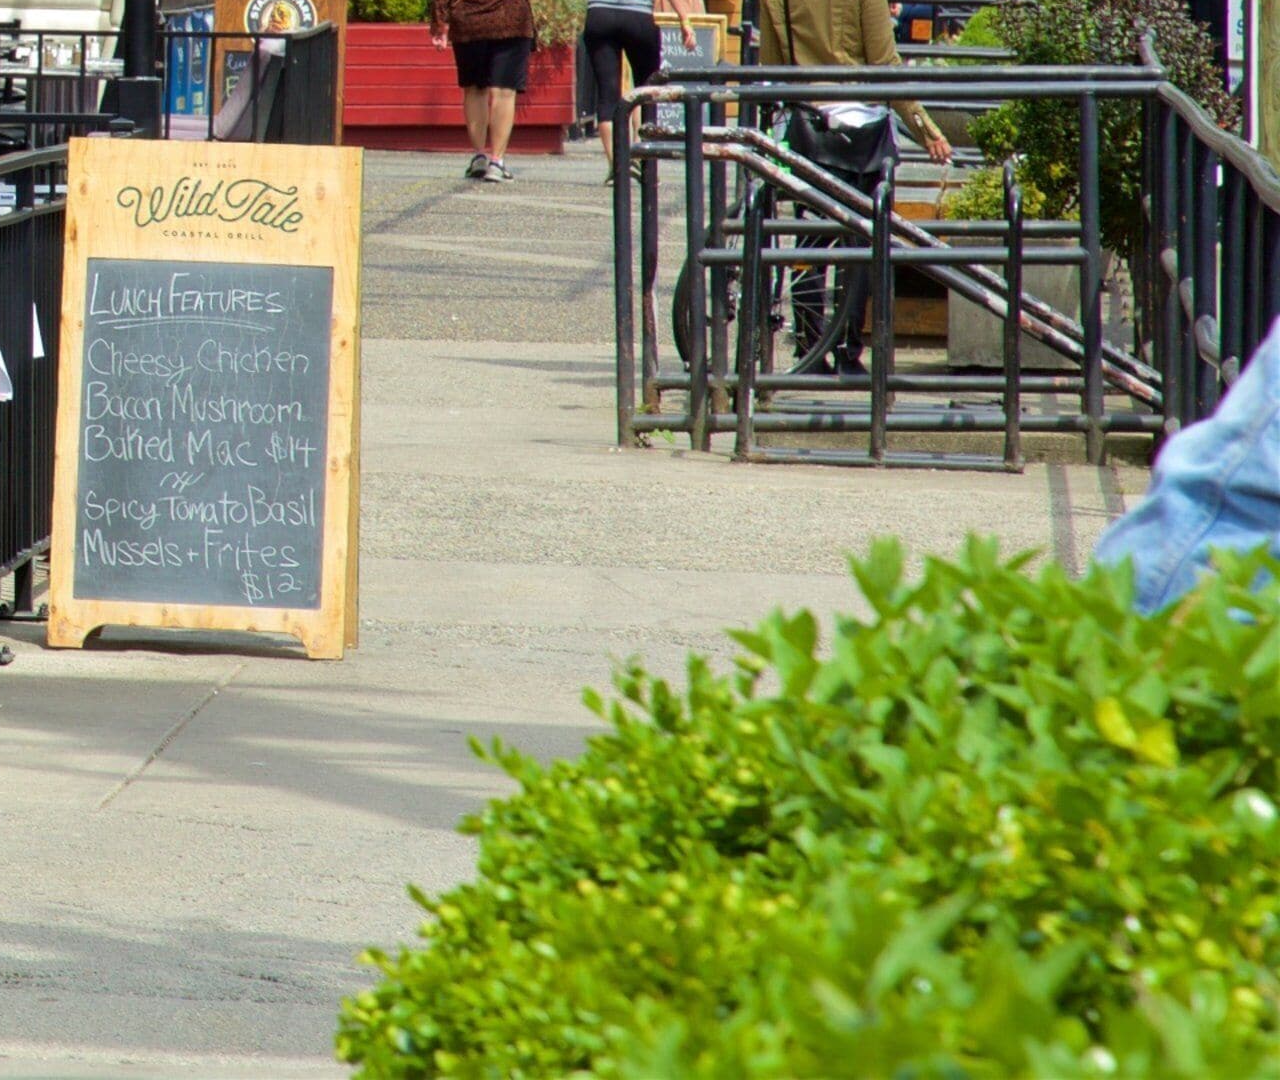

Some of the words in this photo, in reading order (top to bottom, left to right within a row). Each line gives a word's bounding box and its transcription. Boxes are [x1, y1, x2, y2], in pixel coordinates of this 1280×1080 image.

[117, 176, 224, 227] Wild
[218, 178, 303, 233] Tale
[163, 230, 219, 239] COASTAL
[228, 232, 264, 241] GRILL
[90, 273, 161, 317] LUNCH
[88, 338, 191, 387] Cheesy
[197, 339, 309, 373] Chicken
[87, 381, 162, 421] Bacon
[172, 383, 302, 424] Mushroom
[85, 425, 175, 462] Baked
[188, 429, 258, 466] Mac
[265, 431, 317, 468] $14
[85, 490, 161, 530] Spicy
[159, 491, 248, 525] Tomato
[248, 484, 315, 527] Basil
[83, 528, 182, 568] Mussels
[205, 526, 300, 570] Frites
[242, 570, 303, 605] $12
